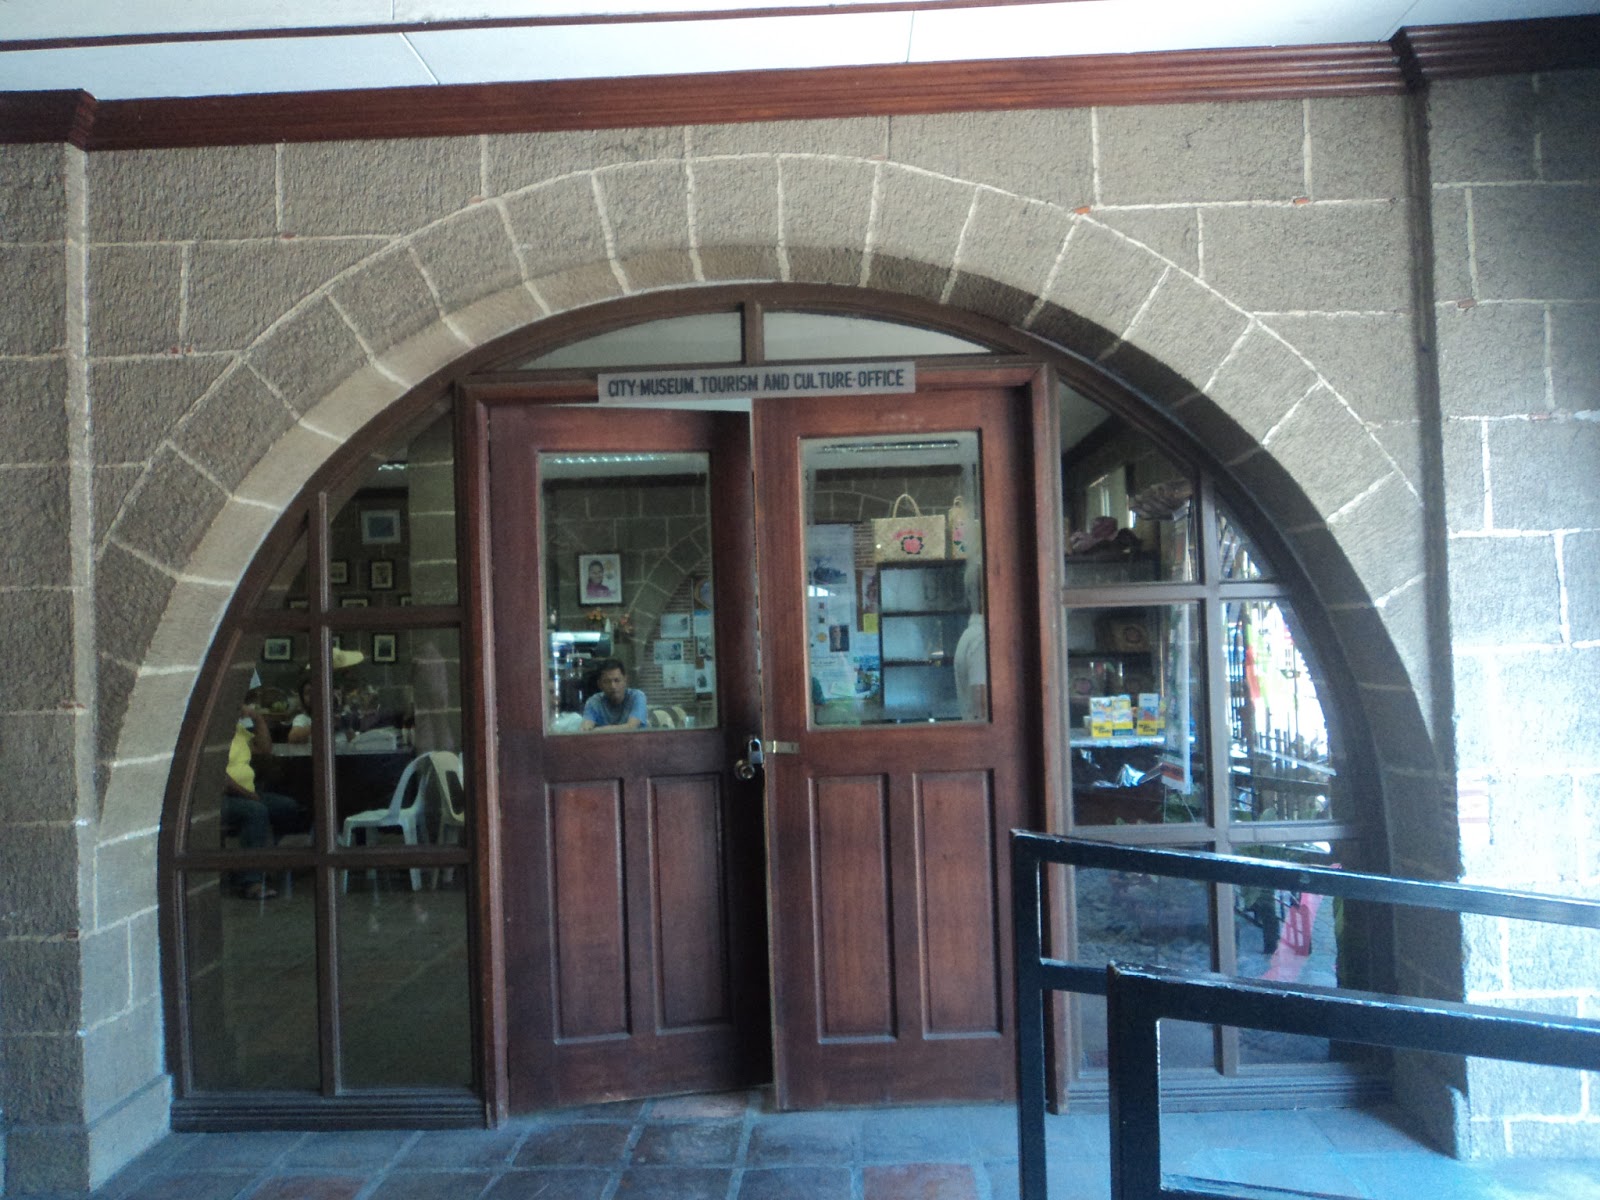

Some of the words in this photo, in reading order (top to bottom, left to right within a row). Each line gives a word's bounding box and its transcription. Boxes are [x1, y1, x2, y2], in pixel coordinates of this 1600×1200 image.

[608, 379, 635, 397] CITY
[700, 374, 758, 394] TOURISM
[763, 373, 790, 391] AND
[794, 371, 853, 390] CULTURE
[858, 369, 904, 387] OFFICE
